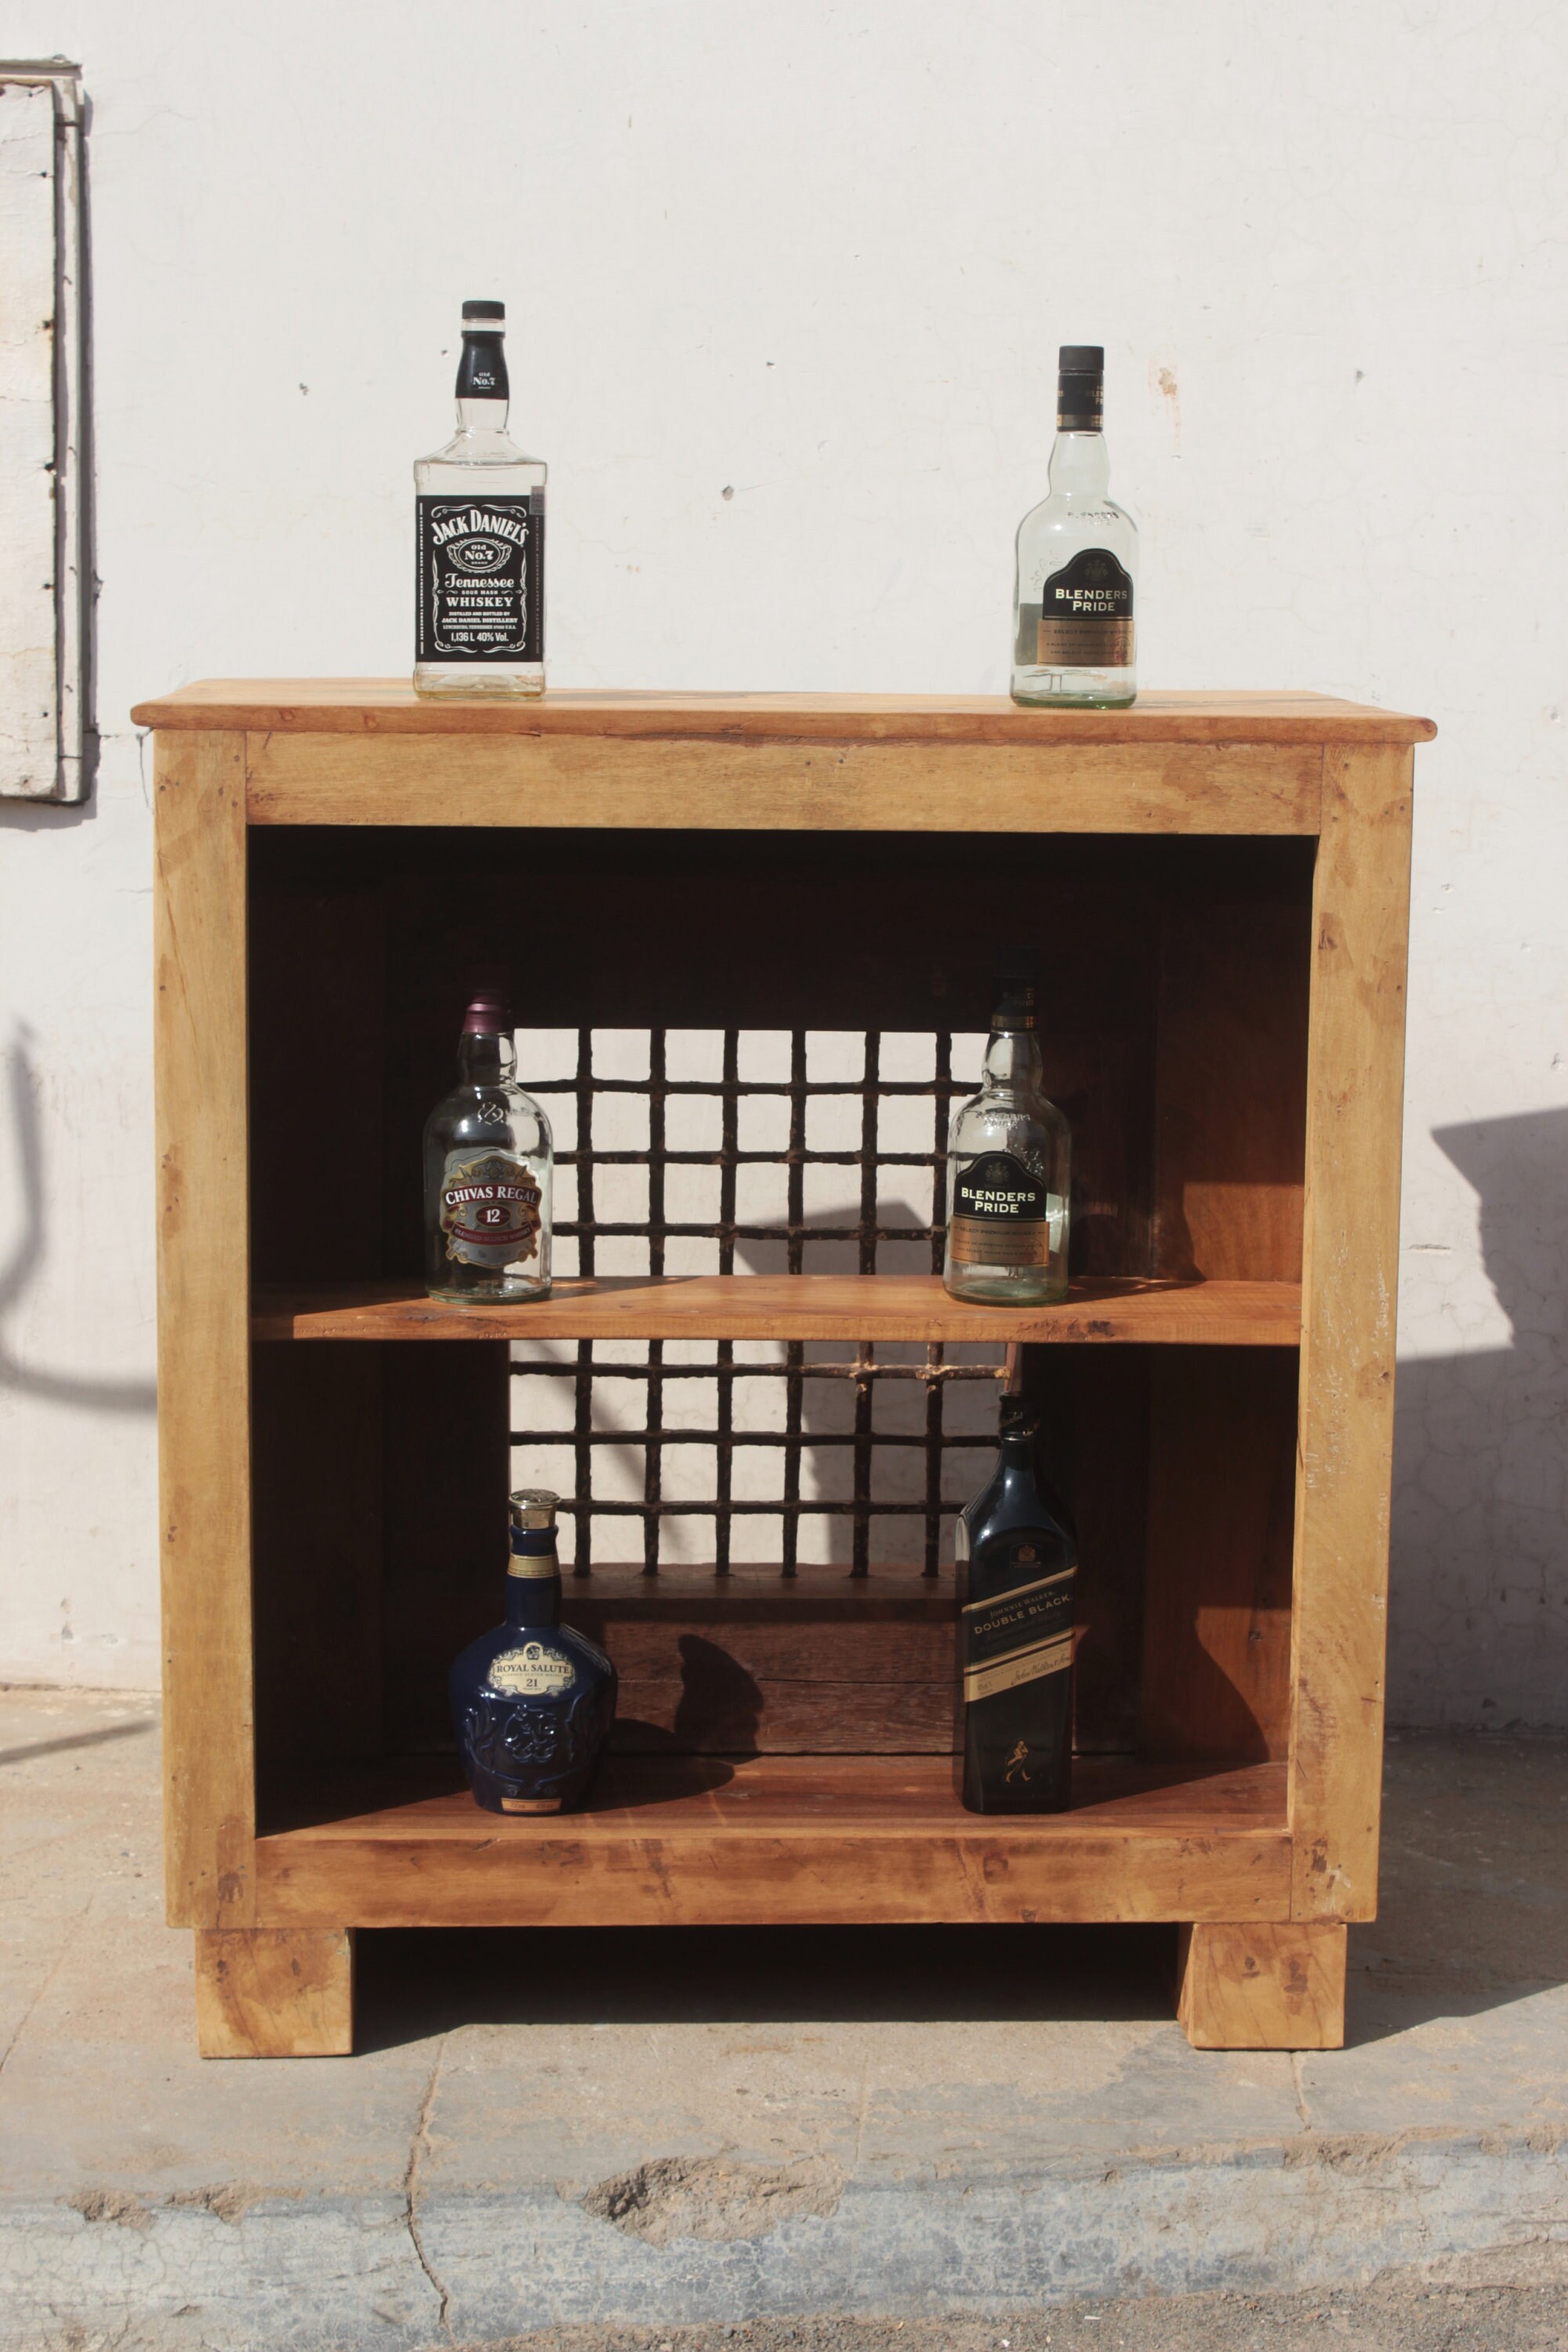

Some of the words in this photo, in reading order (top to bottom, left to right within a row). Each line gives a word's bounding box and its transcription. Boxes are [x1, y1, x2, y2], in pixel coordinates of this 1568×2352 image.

[473, 376, 495, 385] No.7
[431, 516, 470, 545] JACK
[470, 510, 529, 546] DANIEL'S
[464, 550, 495, 561] No.7
[445, 573, 514, 588] Tennessee
[1055, 588, 1127, 600] BLENDERS
[446, 597, 514, 607] WHISKEY
[1073, 601, 1116, 612] PRIDE
[470, 632, 475, 641] L
[476, 632, 494, 641] 40%
[495, 632, 510, 642] Vol.
[445, 1186, 494, 1205] CHIVAS
[497, 1186, 537, 1203] REGAL
[961, 1187, 1036, 1202] BLENDERS
[975, 1200, 1019, 1213] PRIDE
[486, 1208, 500, 1223] 12
[974, 1610, 1025, 1635] DOUBLE
[1029, 1594, 1070, 1615] BLACK
[990, 1602, 1022, 1619] JOHNNIE
[496, 1664, 528, 1673] ROYAL
[531, 1664, 570, 1674] SALUTE
[526, 1678, 538, 1687] 21
